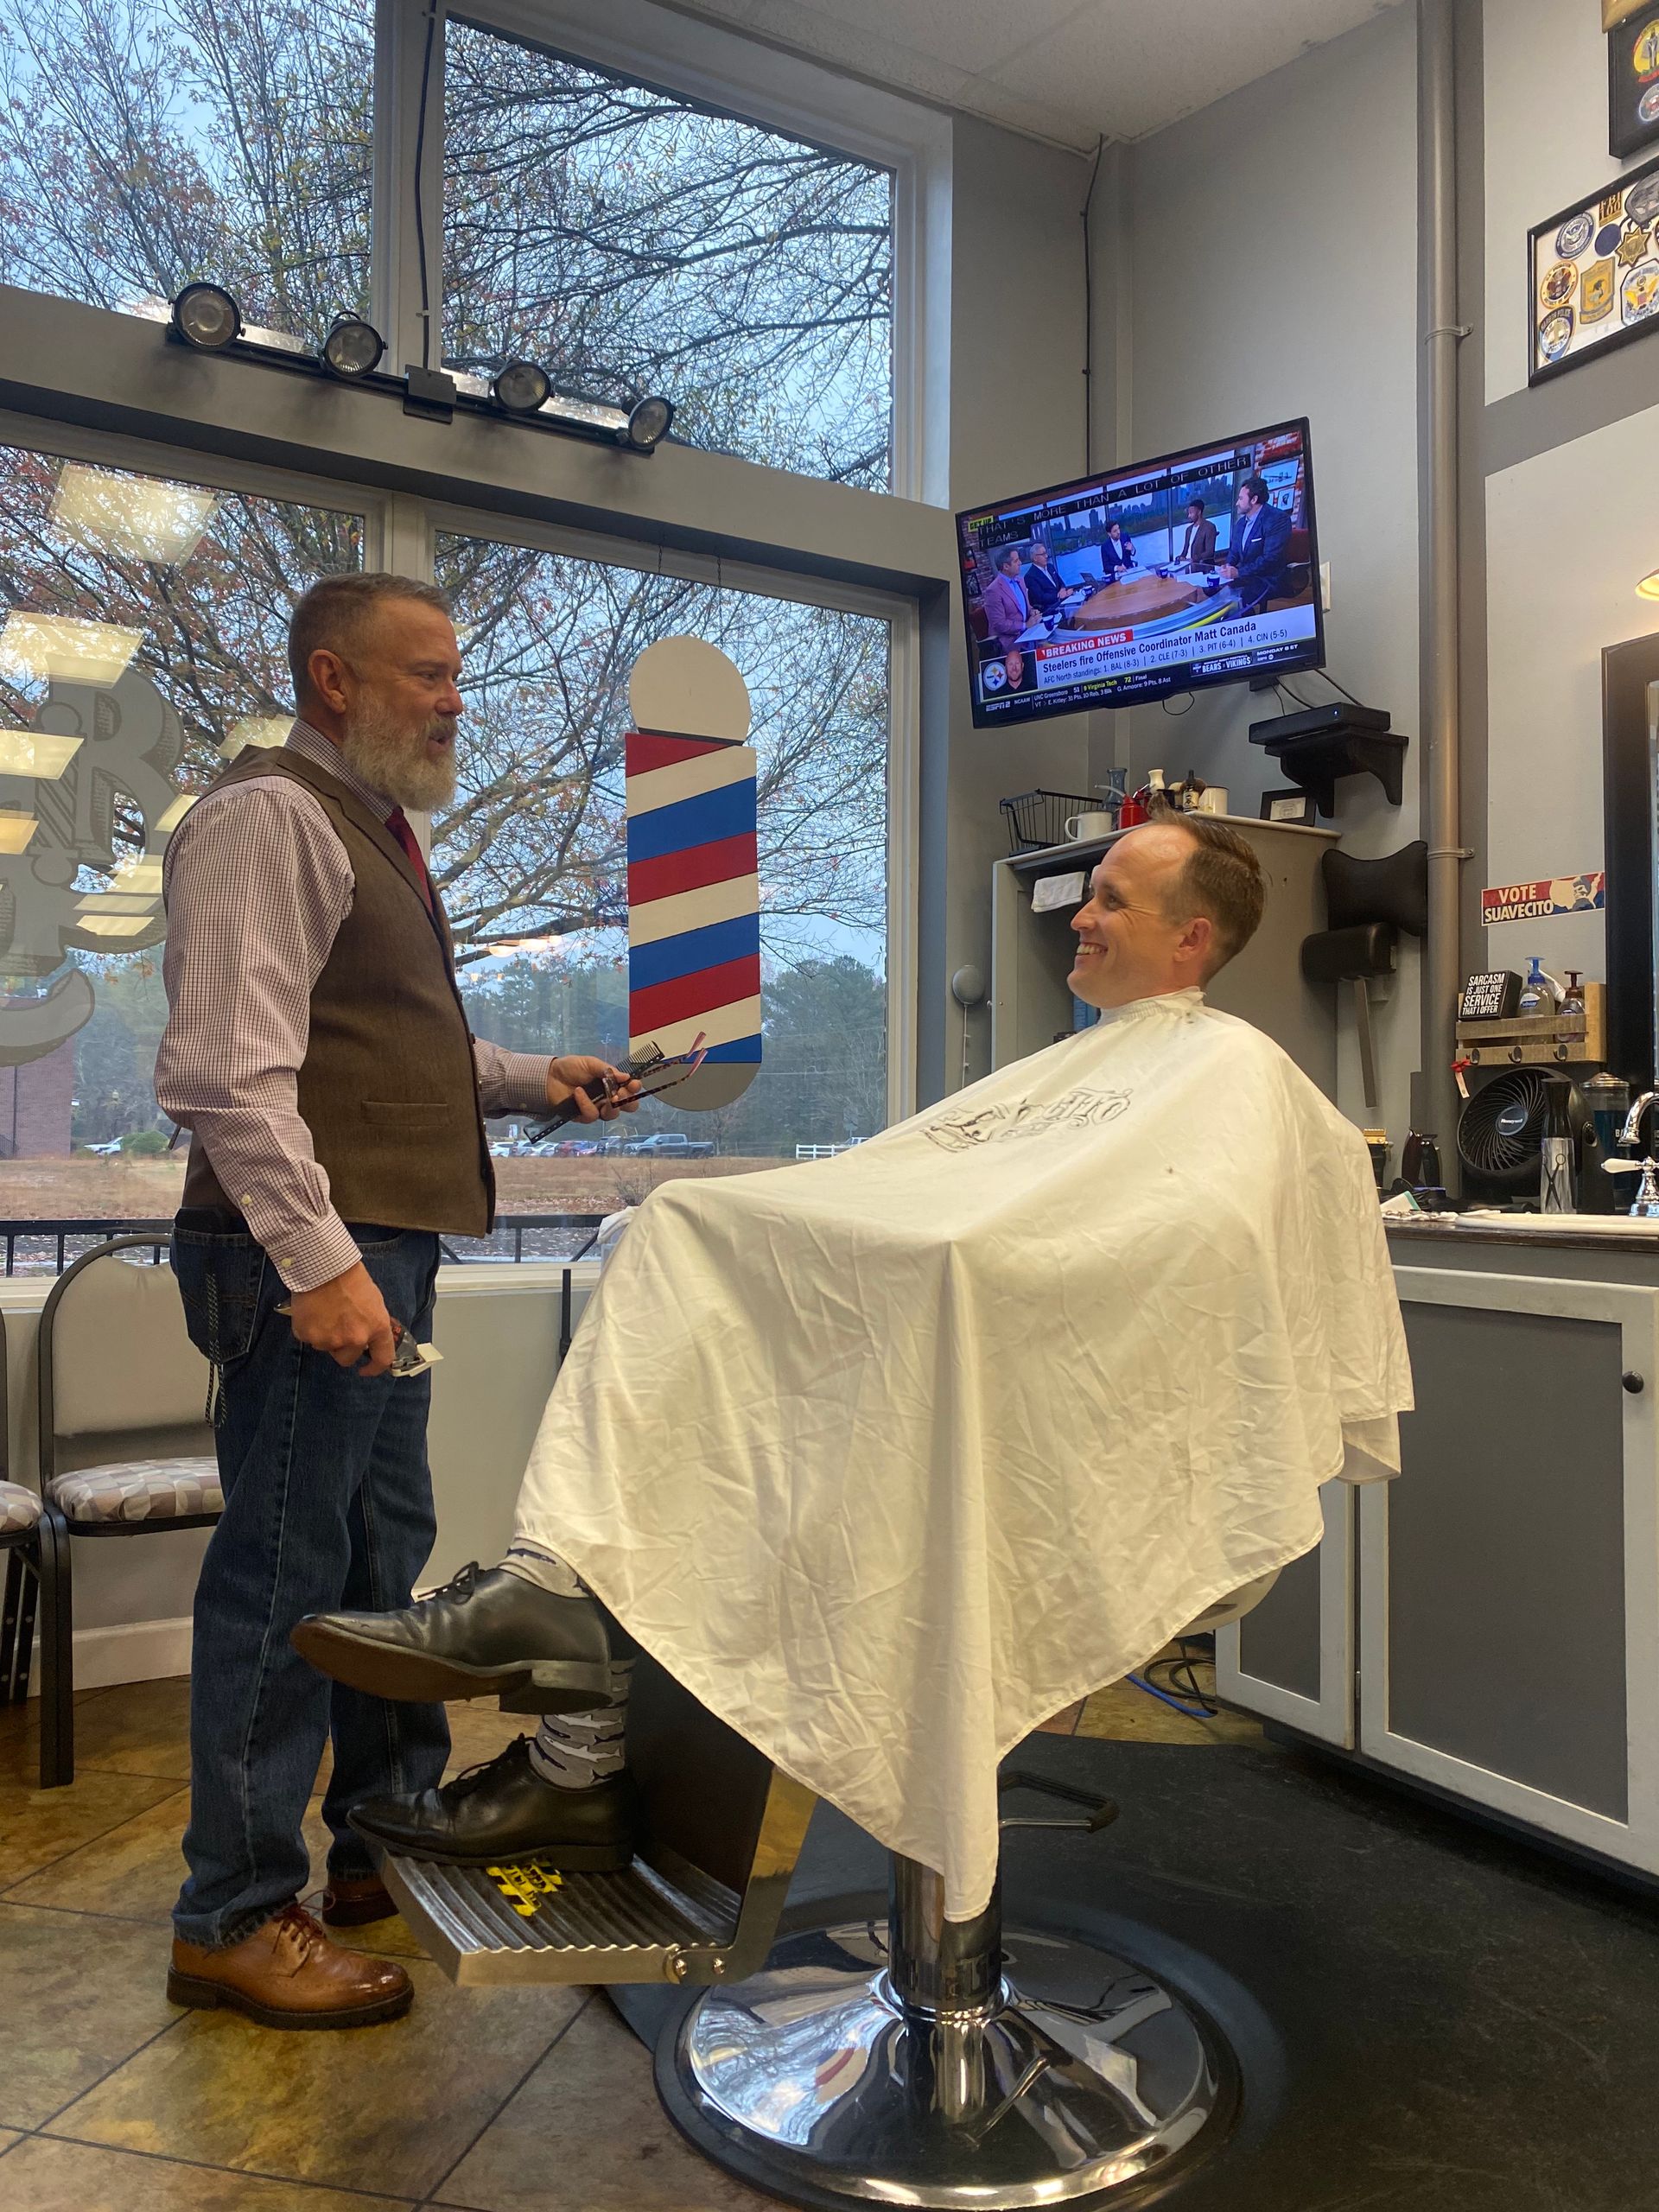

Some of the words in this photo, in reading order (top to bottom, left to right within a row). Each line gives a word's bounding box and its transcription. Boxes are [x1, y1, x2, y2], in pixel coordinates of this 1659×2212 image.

[1033, 505, 1066, 521] MORE
[1076, 493, 1110, 510] THAN
[1118, 488, 1128, 499] A
[1135, 479, 1161, 494] LOT
[1170, 471, 1190, 484] OF
[1198, 456, 1248, 477] OTHER
[979, 531, 1019, 547] TEAMS
[1043, 659, 1077, 673] Steelers
[1079, 655, 1094, 666] fire
[1096, 646, 1136, 662] Offensive
[1139, 635, 1192, 653] Coordinator
[1194, 628, 1217, 643] Matt
[1220, 621, 1256, 637] Canada
[1046, 639, 1095, 658] BREAKING
[1097, 632, 1127, 646] NEWS
[1256, 646, 1283, 657] MONDAY
[1044, 676, 1054, 684] AFC
[1056, 672, 1071, 682] North
[1072, 667, 1102, 679] standings:
[1110, 663, 1122, 671] BAL
[1123, 658, 1140, 670] (8-3)
[1158, 652, 1170, 662] CLE
[1171, 649, 1188, 660] (7-3)
[1207, 642, 1217, 652] PIT
[1219, 639, 1236, 650] (6-4)
[1256, 632, 1268, 642] CIN
[1269, 629, 1287, 640] (5-5)
[1202, 662, 1222, 673] BEARS
[1225, 657, 1251, 669] VIKINGS
[1088, 682, 1105, 691] Virginia
[1105, 679, 1118, 688] Tech
[1044, 690, 1069, 699] Greensboro
[1498, 884, 1536, 905] VOTE
[1484, 899, 1554, 924] SUAVECITO
[1468, 973, 1505, 987] SARCASM
[1466, 986, 1473, 995] IS
[1473, 985, 1490, 995] JUST
[1490, 983, 1503, 993] ONE
[1464, 993, 1500, 1007] SERVICE
[1462, 1007, 1477, 1015] THAT
[1480, 1004, 1498, 1014] OFFER
